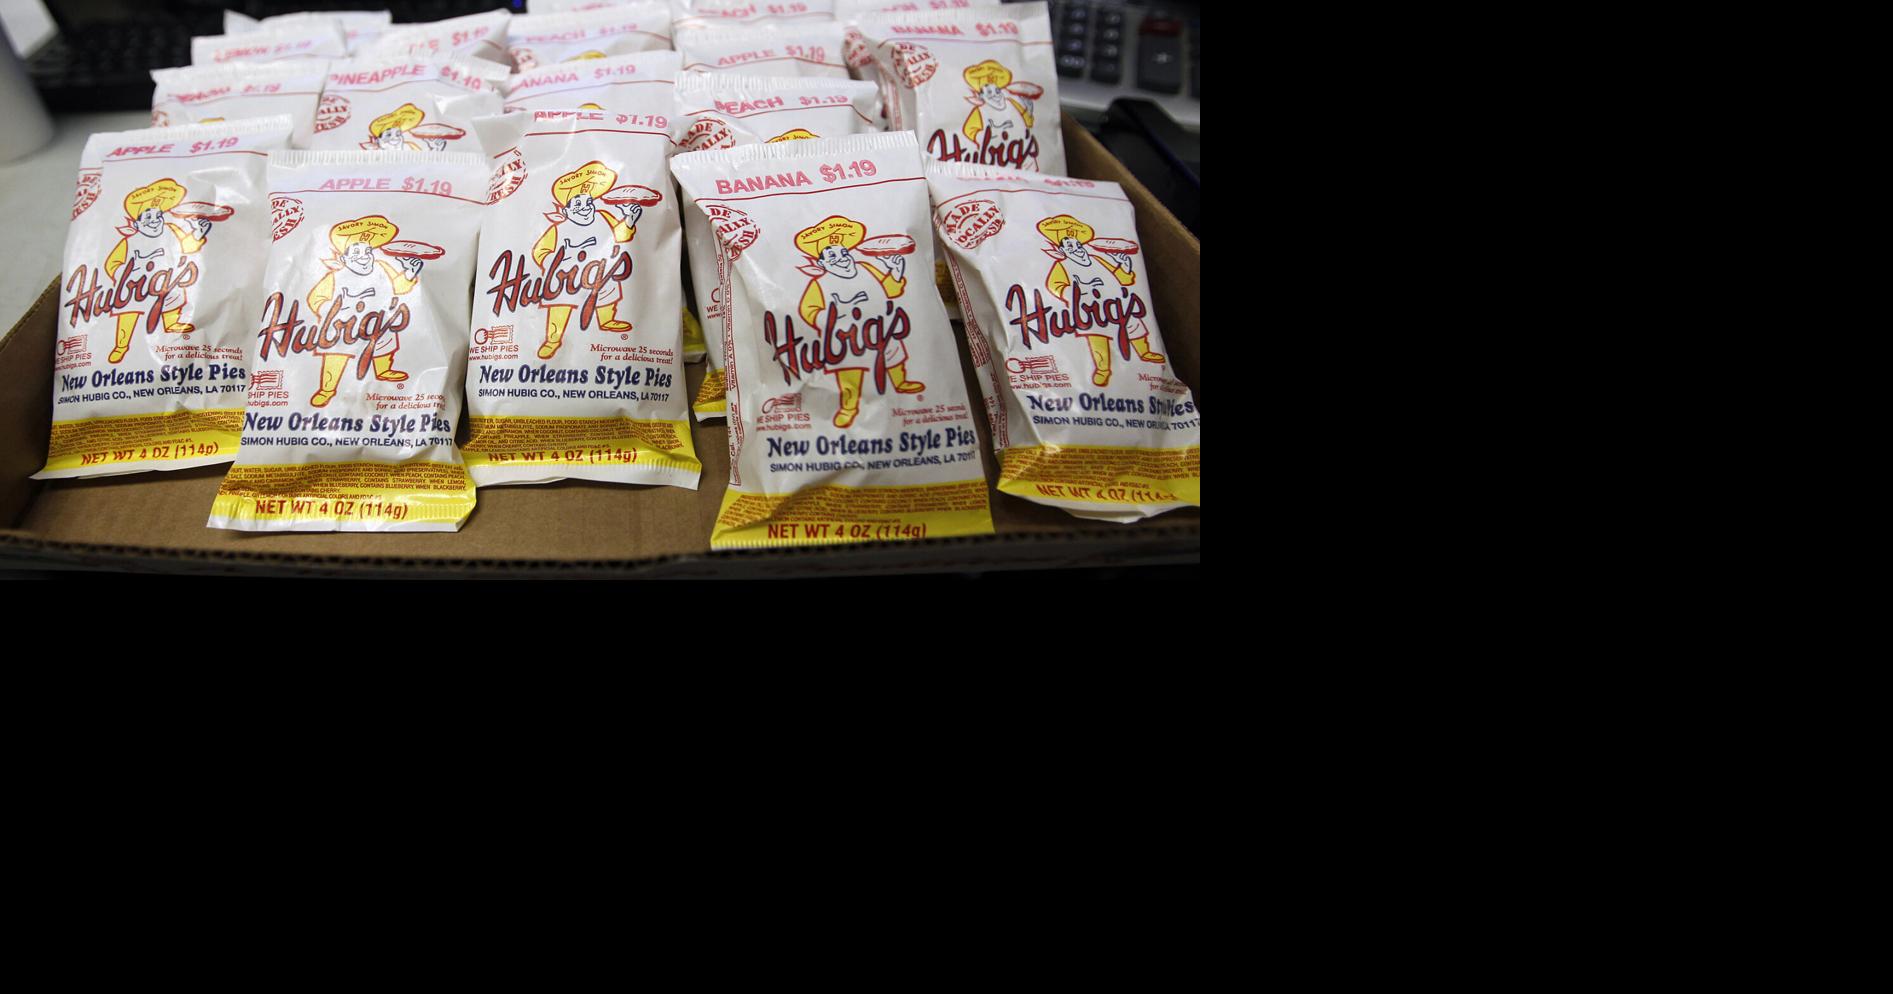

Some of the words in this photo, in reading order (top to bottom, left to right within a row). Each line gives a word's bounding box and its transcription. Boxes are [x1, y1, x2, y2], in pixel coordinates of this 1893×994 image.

[718, 49, 776, 65] APPLE
[784, 45, 826, 63] $1.19
[511, 72, 579, 93] ANANA
[594, 65, 636, 79] $1.19
[318, 105, 348, 115] ALLY
[616, 114, 668, 129] $1.19
[107, 143, 175, 157] APPLE
[190, 137, 239, 153] $1.19
[926, 128, 1040, 170] Hubig's
[319, 178, 391, 190] APPLE
[401, 176, 452, 195] $1.19
[560, 173, 583, 185] SAVORY
[715, 171, 813, 195] BANANA
[819, 159, 877, 184] $1.19
[272, 206, 300, 227] ALLY
[718, 217, 751, 234] ALLY
[947, 203, 980, 233] MADE
[956, 205, 999, 243] OCALLY
[338, 222, 364, 232] SAVORY
[367, 221, 389, 230] SIMON
[800, 225, 825, 240] SAVORY
[828, 222, 854, 230] SIMON
[64, 256, 199, 334] Hubig's
[487, 244, 632, 331] Hubig's
[1005, 281, 1147, 362] Hubig's
[257, 291, 410, 380] Hubig's
[155, 344, 200, 353] Microwave
[202, 344, 212, 352] 25
[213, 346, 243, 354] seconds
[164, 352, 176, 361] for
[185, 352, 219, 360] delicious
[480, 345, 499, 353] SHIP
[500, 344, 519, 352] PIES
[590, 344, 637, 353] Microwave
[649, 348, 674, 357] seconds
[764, 300, 911, 395] Hubig's
[75, 353, 92, 361] PIES
[600, 353, 613, 362] for
[622, 353, 655, 363] delicious
[656, 356, 674, 365] treat!
[61, 374, 87, 392] New
[92, 368, 154, 388] Orleans
[160, 362, 203, 385] Style
[208, 362, 246, 381] Pies
[479, 365, 513, 384] New
[518, 364, 589, 384] Orleans
[595, 365, 641, 389] Style
[645, 367, 672, 388] Pies
[57, 395, 80, 405] SIMON
[82, 392, 110, 403] HUBIG
[112, 391, 132, 401] CO.,
[133, 388, 155, 398] NEW
[157, 385, 203, 396] ORLEANS,
[205, 385, 218, 394] LA
[220, 384, 247, 393] 70117
[248, 391, 265, 399] SHIP
[268, 391, 289, 399] PIES
[366, 393, 412, 401] Microwave
[478, 389, 505, 398] SIMON
[507, 389, 537, 398] HUBIG
[539, 389, 561, 399] CO.,
[562, 390, 586, 399] NEW
[588, 390, 640, 401] ORLEANS,
[641, 392, 650, 401] LA
[650, 392, 669, 402] 70117
[1027, 396, 1073, 413] New
[1079, 392, 1144, 414] Orleans
[376, 402, 388, 410] for
[398, 402, 431, 410] delicious
[935, 404, 945, 413] 25
[243, 412, 283, 431] New
[288, 412, 364, 432] Orleans
[369, 414, 415, 438] Style
[419, 413, 451, 433] Pies
[765, 414, 784, 423] SHIP
[787, 413, 810, 421] PIES
[1032, 416, 1070, 426] SIMON
[1072, 417, 1104, 427] HUBIG
[1106, 418, 1125, 428] CO.,
[1126, 419, 1145, 428] NEW
[240, 437, 274, 446] SIMON
[276, 437, 309, 446] HUBIG
[311, 437, 333, 447] CO.,
[335, 438, 361, 446] NEW
[362, 438, 413, 448] ORLEANS,
[415, 438, 427, 447] LA
[428, 437, 453, 446] 70117
[767, 436, 810, 458] New
[816, 434, 893, 457] Orleans
[899, 427, 942, 457] Style
[945, 425, 976, 449] Pies
[81, 451, 109, 465] NET
[112, 449, 135, 461] WT
[139, 447, 147, 458] 4
[152, 446, 171, 458] OZ
[174, 441, 219, 459] (114g)
[489, 450, 517, 462] NET
[522, 450, 545, 462] WT
[550, 450, 560, 462] 4
[565, 449, 584, 462] OZ
[589, 448, 638, 464] (114g)
[770, 463, 803, 472] SIMON
[806, 461, 842, 471] HUBIG
[867, 460, 892, 470] NEW
[892, 455, 942, 468] ORLEANS,
[943, 454, 955, 463] LA
[1036, 484, 1066, 497] NET
[255, 500, 286, 515] NET
[290, 500, 314, 514] WT
[319, 501, 328, 514] 4
[334, 501, 354, 515] OZ
[359, 500, 408, 520] (114g)
[768, 523, 799, 539] NET
[804, 523, 831, 538] WT
[835, 523, 845, 538] 4
[850, 523, 871, 538] OZ
[876, 522, 928, 540] (114g)
